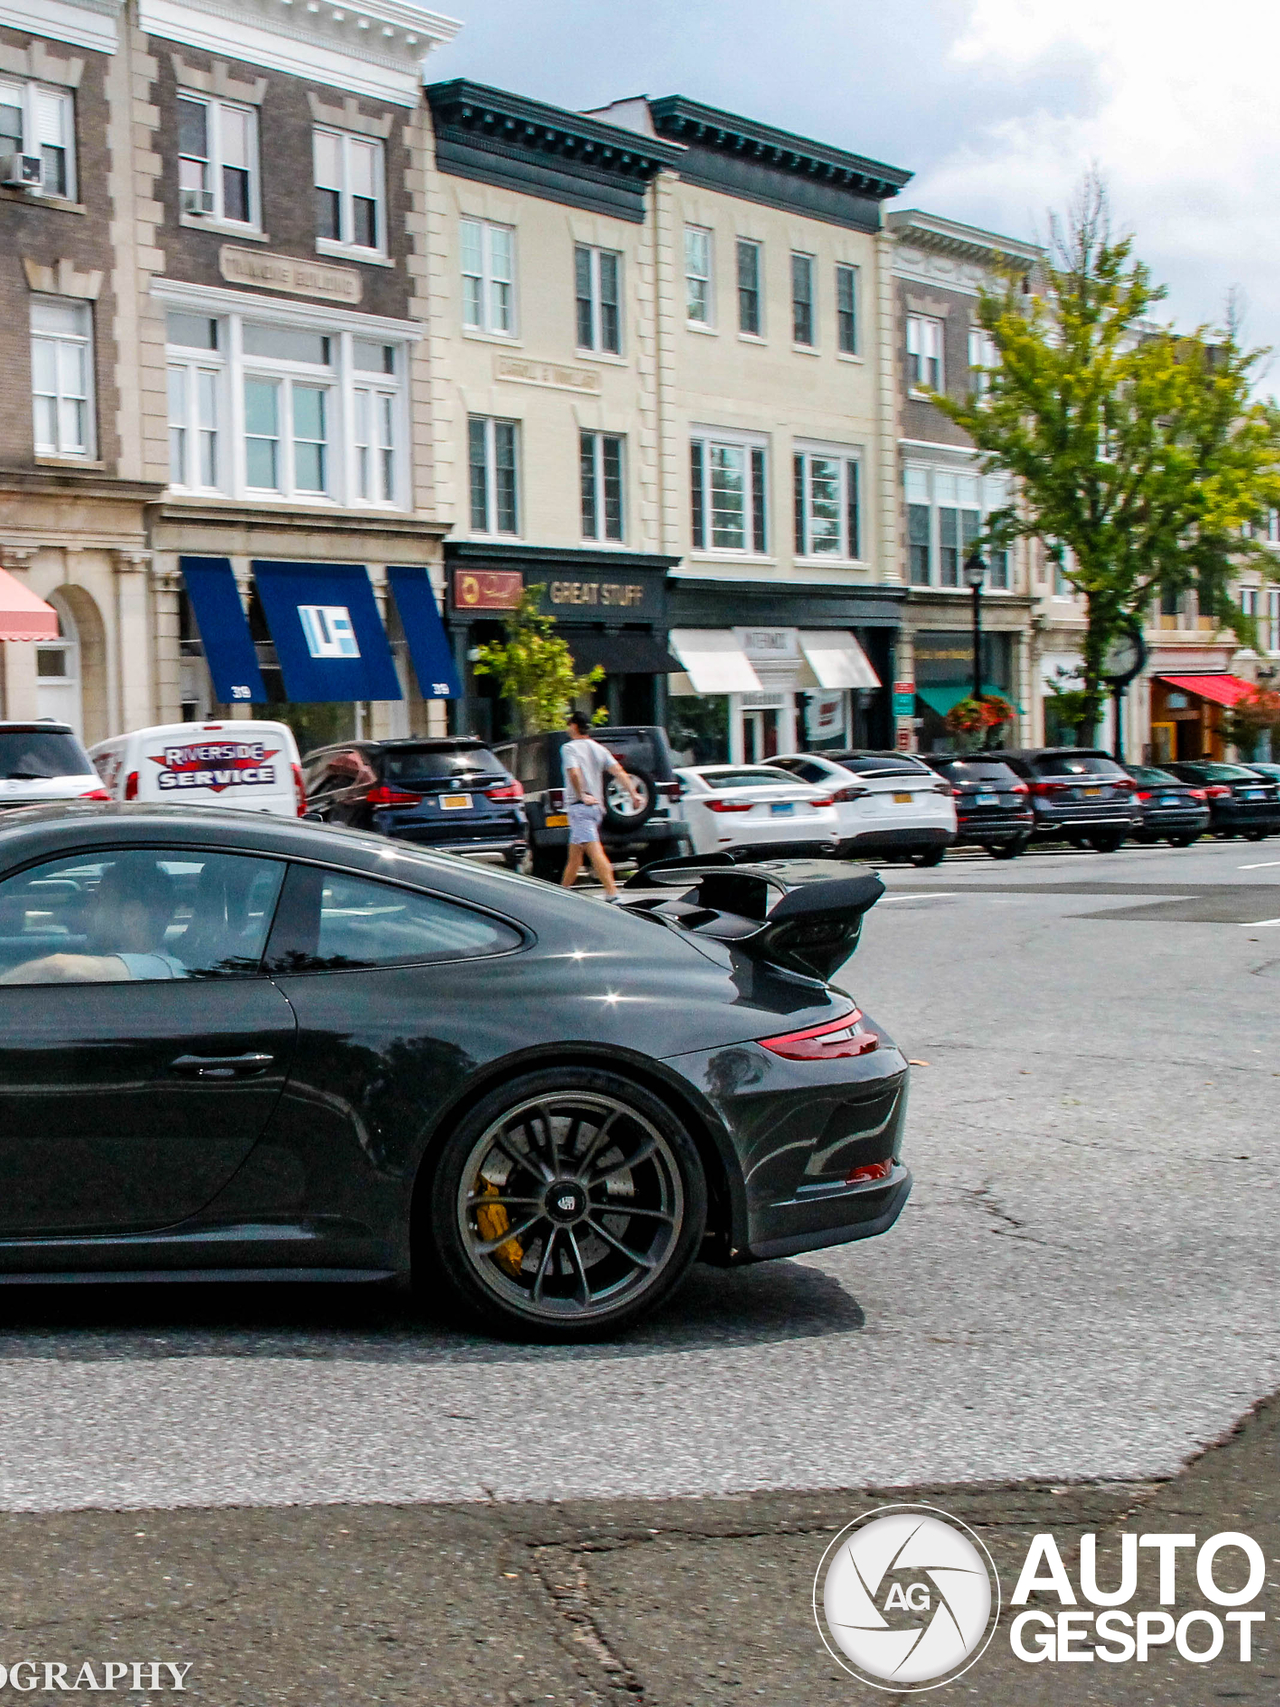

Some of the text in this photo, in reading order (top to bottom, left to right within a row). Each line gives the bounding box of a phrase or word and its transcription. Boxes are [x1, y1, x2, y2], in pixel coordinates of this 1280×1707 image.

[550, 581, 643, 606] GREAT STUFF
[165, 742, 265, 766] RIVERSIDE
[159, 767, 275, 789] SERVICE
